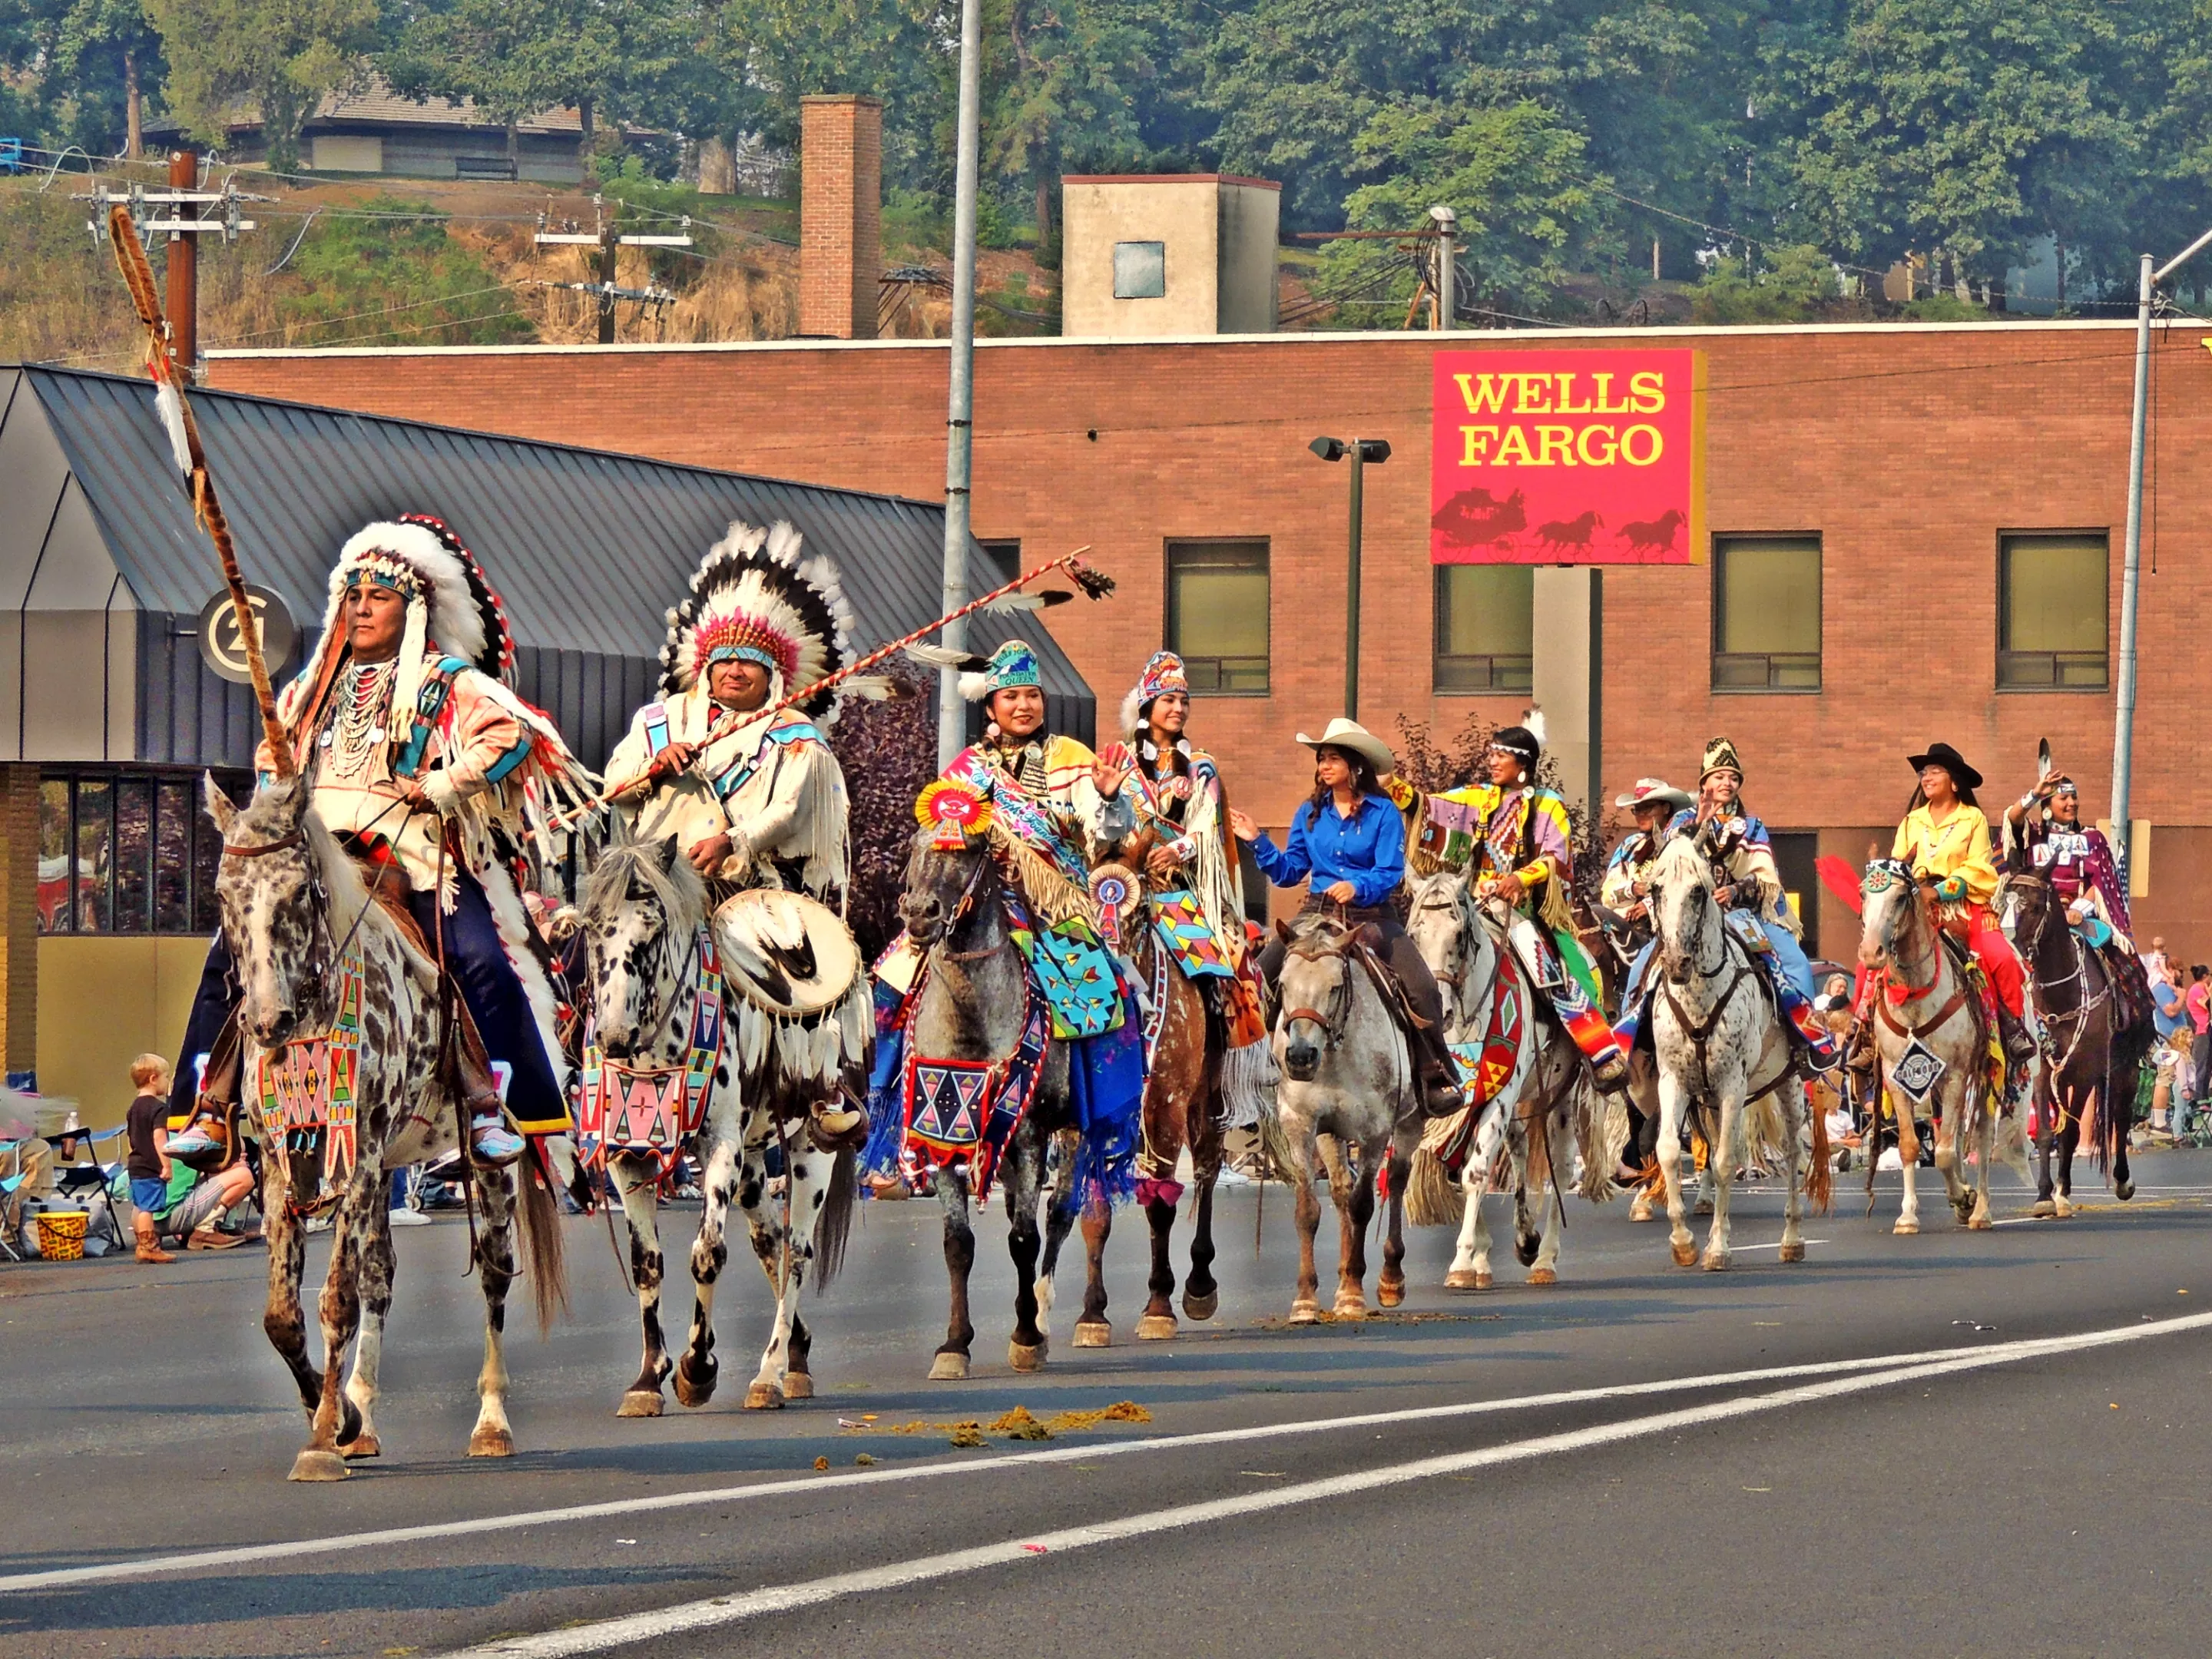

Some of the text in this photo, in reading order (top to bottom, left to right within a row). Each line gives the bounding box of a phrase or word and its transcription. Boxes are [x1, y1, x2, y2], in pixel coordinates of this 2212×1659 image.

[1453, 372, 1666, 414] WELLS
[1459, 424, 1664, 466] FARGO
[1005, 677, 1034, 686] QUEEN
